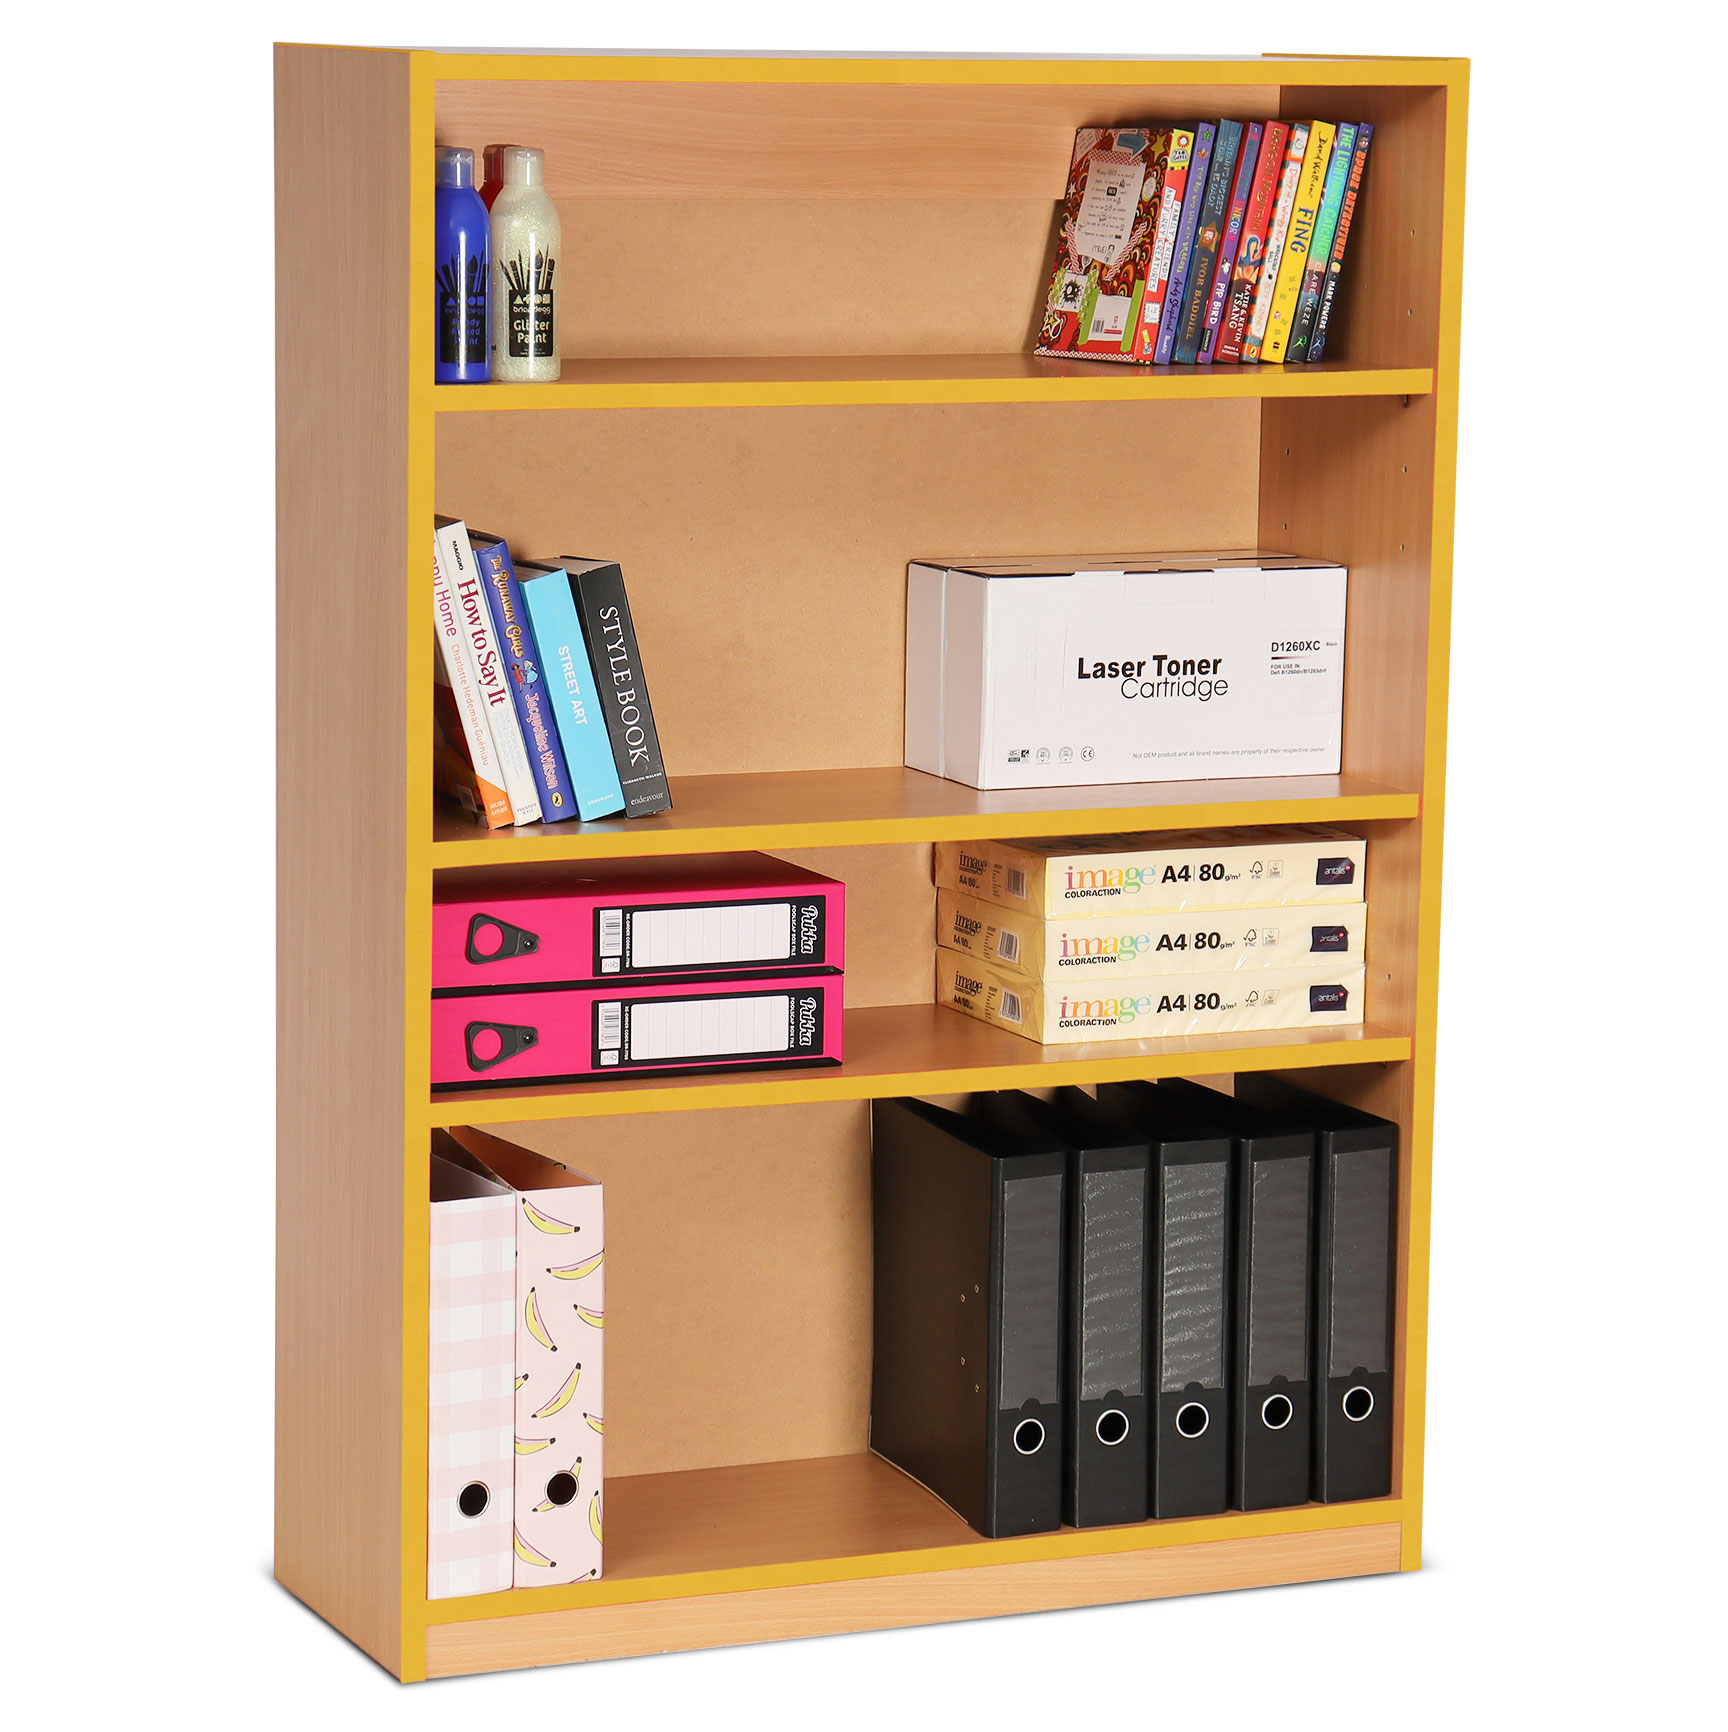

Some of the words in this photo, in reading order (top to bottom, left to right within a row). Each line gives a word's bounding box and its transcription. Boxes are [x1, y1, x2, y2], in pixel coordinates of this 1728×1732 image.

[1341, 127, 1355, 149] THE
[1328, 152, 1350, 206] LIGHTNING
[1228, 200, 1245, 242] UNICORN
[1291, 206, 1315, 253] FING
[1318, 207, 1338, 256] CATCHER
[1197, 256, 1209, 286] IVOR
[1308, 261, 1321, 295] CLARE
[1215, 282, 1226, 298] PIP
[1241, 283, 1253, 309] KATIE
[1325, 280, 1336, 300] MARK
[513, 319, 550, 331] Gliter
[1186, 289, 1202, 340] BADDIEL
[1209, 301, 1222, 325] BIRD
[1228, 292, 1244, 329] TSANG
[1301, 297, 1314, 326] WEZE
[1319, 301, 1331, 330] POWERS
[517, 332, 547, 344] Pant
[1234, 316, 1246, 343] KEVIN
[452, 540, 464, 571] MAGGIO
[435, 589, 457, 638] Home
[457, 577, 482, 627] How
[471, 628, 488, 650] to
[599, 604, 632, 687] STYLE
[1271, 640, 1321, 653] D1260XC
[476, 650, 499, 688] Say
[1077, 656, 1146, 680] Laser
[1152, 654, 1223, 677] Toner
[451, 644, 468, 685] Charlotte
[463, 685, 479, 729] Hedeman
[487, 685, 507, 708] It
[557, 644, 581, 696] STREET
[570, 700, 588, 726] ART
[1120, 673, 1229, 702] Cartridge
[524, 692, 550, 753] Jacqueline
[539, 750, 559, 790] Wilson
[614, 686, 650, 767] BOOK
[1157, 751, 1177, 759] product
[630, 792, 664, 806] endeavour
[959, 850, 987, 876] image
[1324, 865, 1346, 875] antalis
[1064, 865, 1157, 894] image
[1161, 864, 1191, 884] A4
[1199, 863, 1225, 882] 80
[1064, 887, 1122, 899] COLORACTION
[801, 904, 819, 955] Pukka
[955, 910, 982, 937] image
[1319, 933, 1339, 943] antalis
[1058, 956, 1117, 966] COLORACTION
[1059, 933, 1150, 962] image
[1155, 933, 1188, 952] A4
[1194, 931, 1221, 950] 80
[955, 970, 983, 997] image
[1318, 993, 1339, 1002] antalis
[799, 996, 817, 1047] Pukka
[1059, 996, 1152, 1024] image
[1156, 994, 1187, 1014] A4
[1193, 992, 1221, 1011] 80
[1059, 1017, 1117, 1028] COLORACTION
